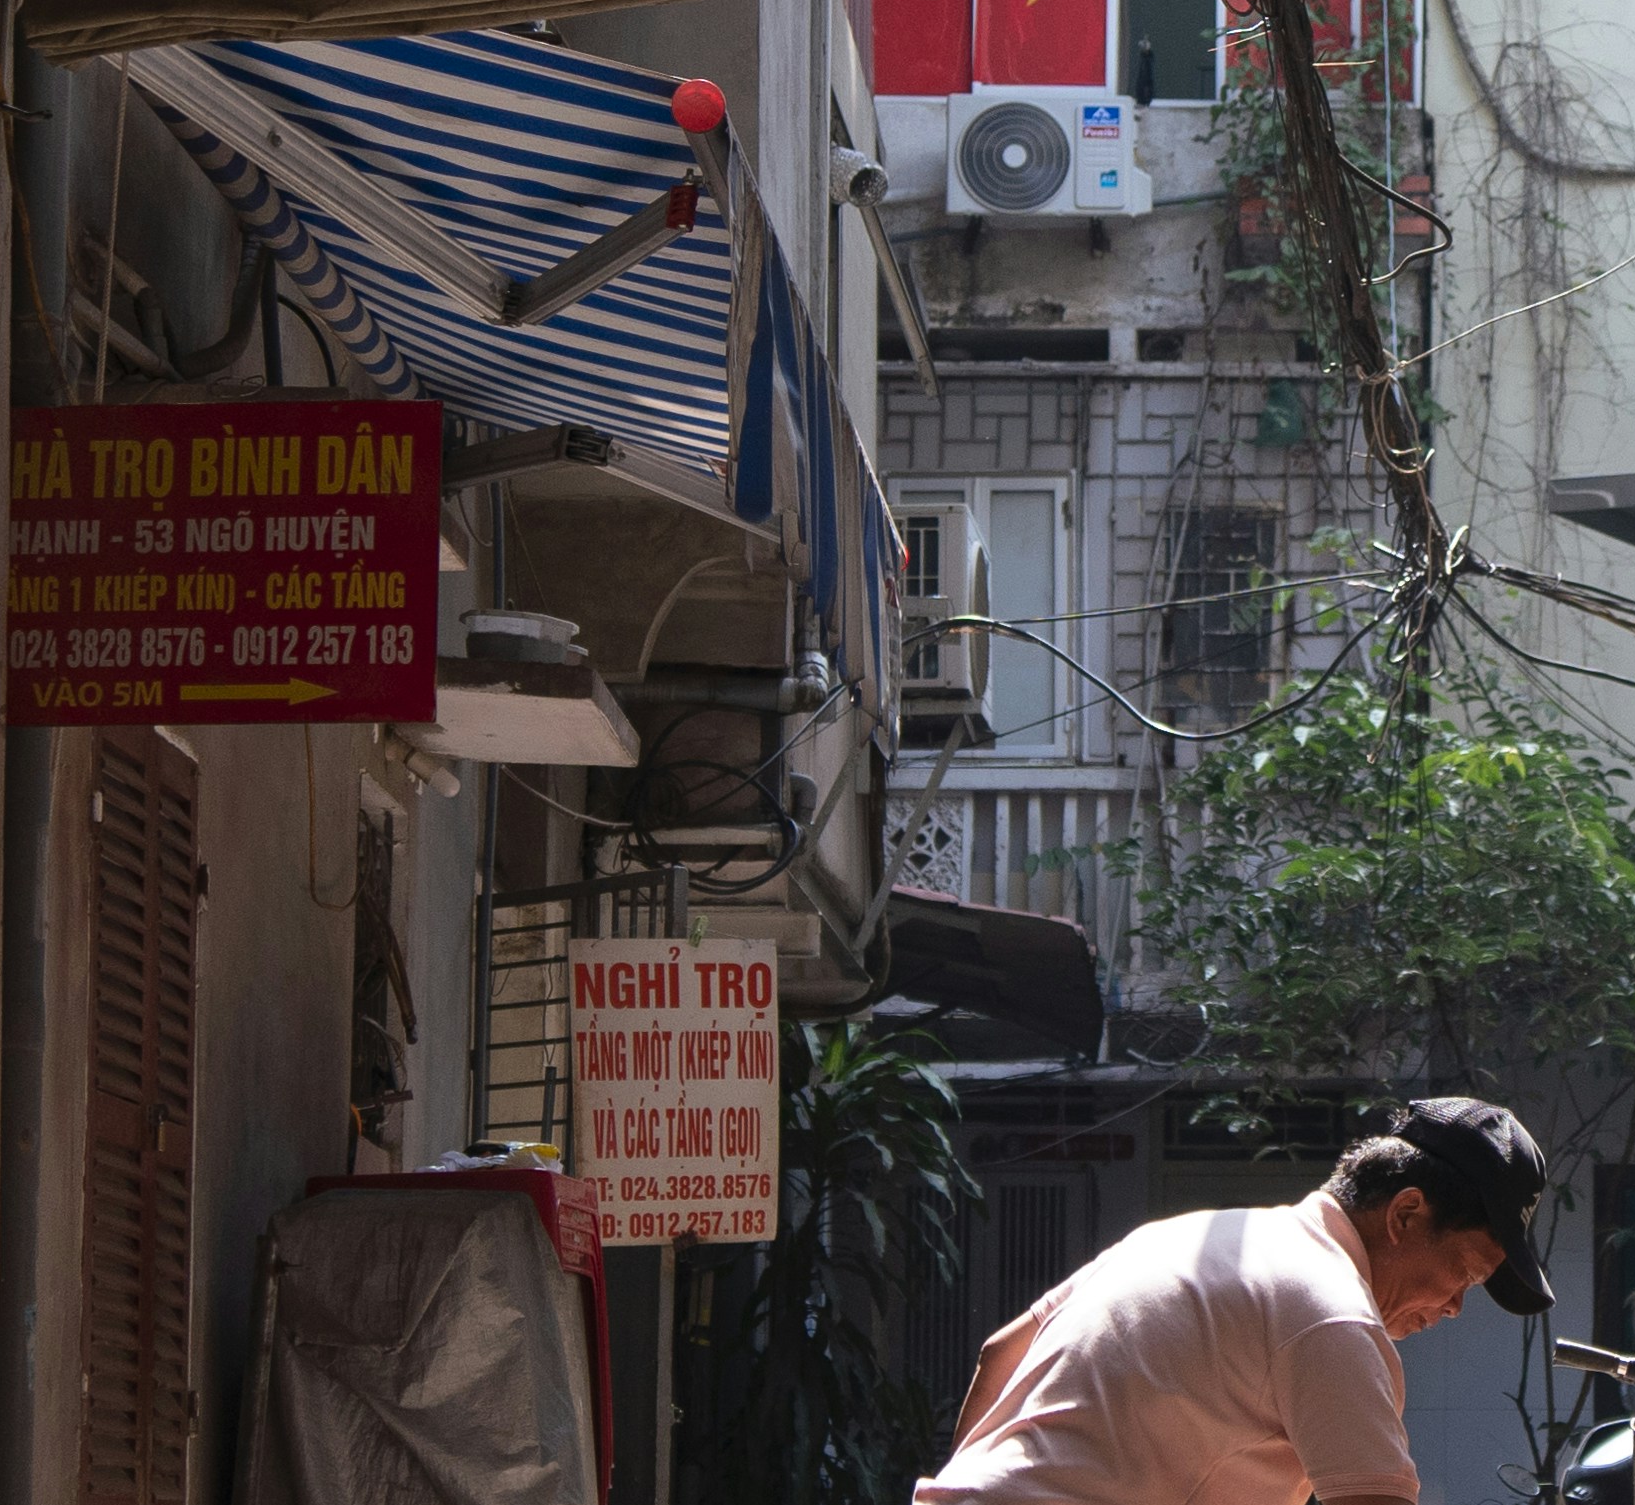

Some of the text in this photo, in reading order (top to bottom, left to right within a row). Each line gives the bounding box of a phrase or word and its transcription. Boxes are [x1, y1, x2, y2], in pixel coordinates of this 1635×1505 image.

[13, 422, 413, 512] HÀ TRỌ BÌNH DÂN
[135, 519, 174, 554] 53
[186, 511, 253, 553] NGÕ
[266, 509, 375, 559] HUYỆN
[8, 565, 59, 613] ẦNG
[70, 576, 82, 612] 1
[94, 568, 167, 612] KHÉP
[177, 567, 236, 614] KÍN)
[266, 567, 322, 610] CÁC
[332, 559, 406, 609] TẦNG
[11, 630, 57, 669] 024
[67, 628, 132, 668] 3828
[140, 627, 205, 667] 8576
[233, 626, 298, 666] 0912
[307, 625, 356, 665] 257
[366, 624, 414, 665] 183
[33, 676, 163, 708] VÀO 5M
[574, 947, 773, 1019] NGHỈ TRỌ
[576, 1014, 774, 1092] TẦNG MỘT (KHÉP KÍN)
[593, 1090, 761, 1168] VÀ CÁC TẦNG (GỌI)
[620, 1173, 771, 1202] 024.3828.8576
